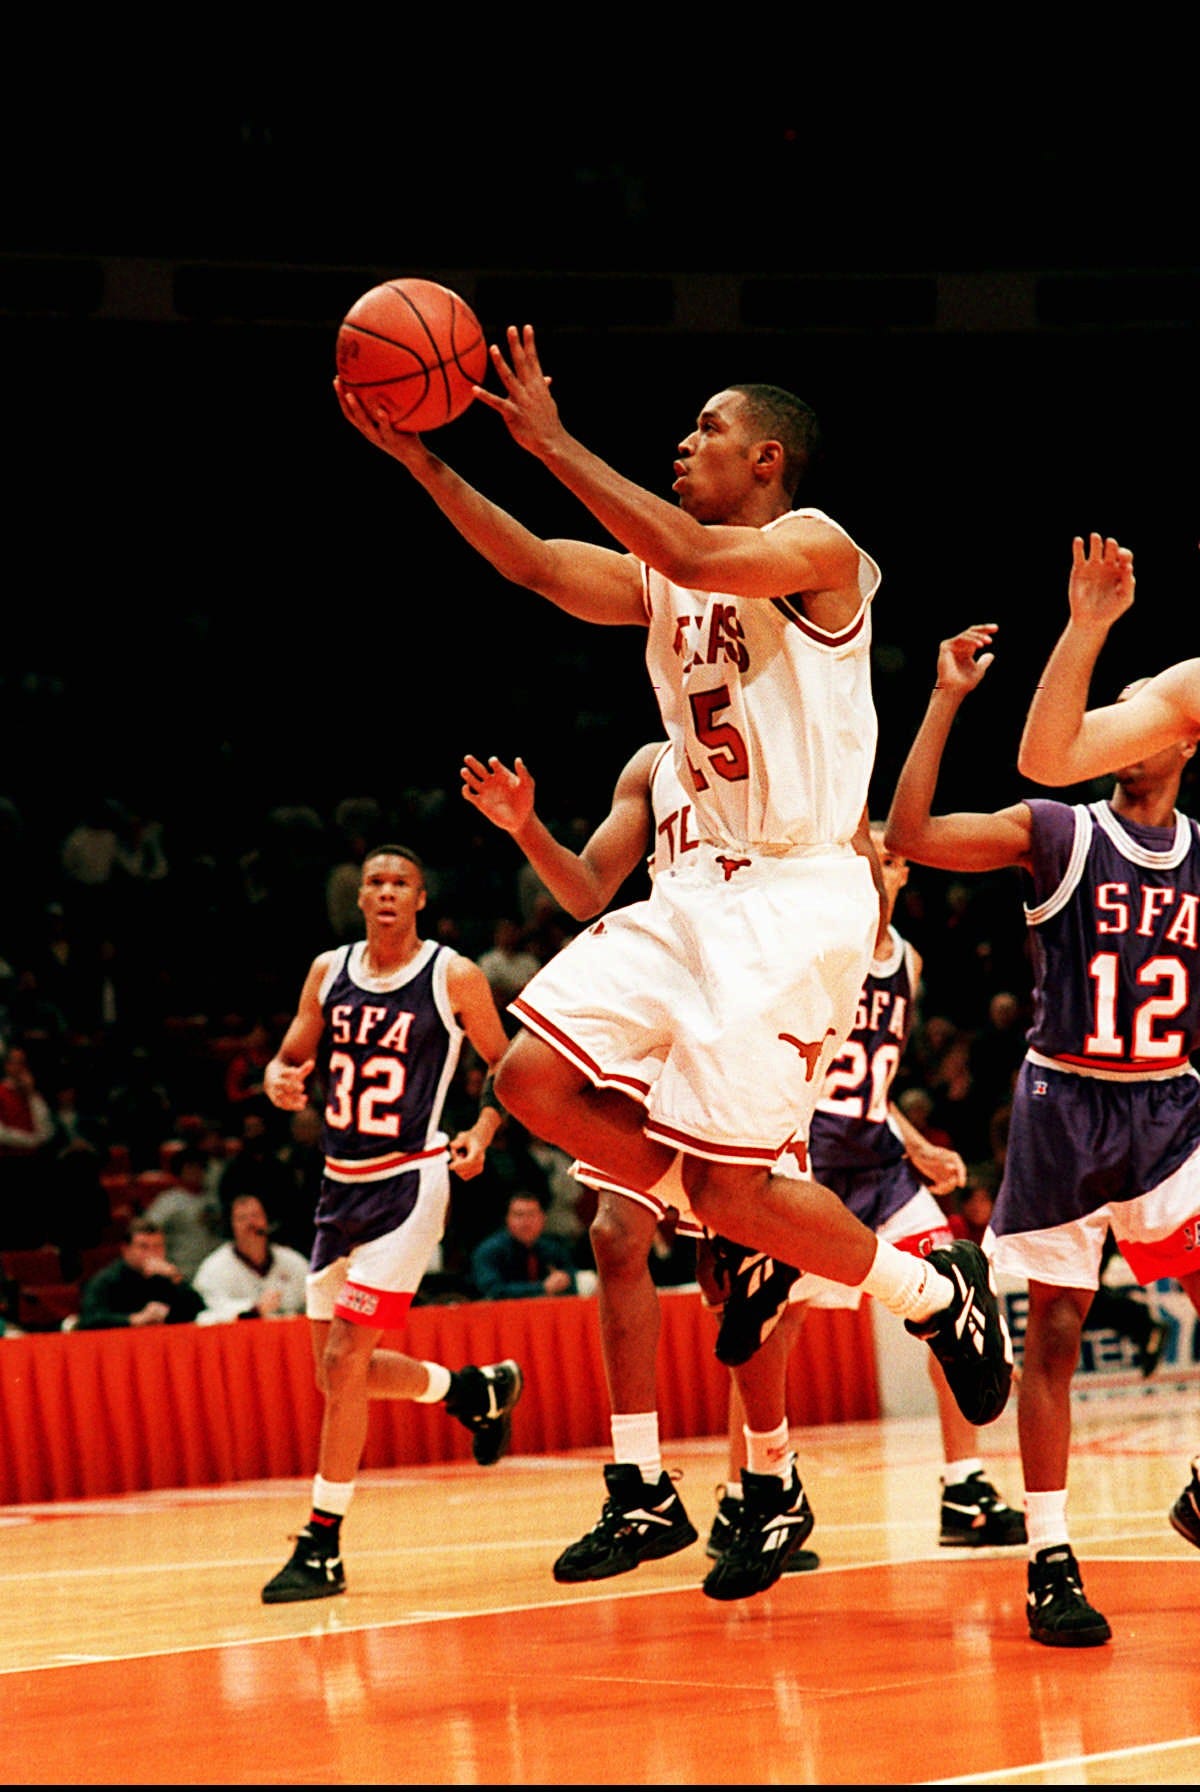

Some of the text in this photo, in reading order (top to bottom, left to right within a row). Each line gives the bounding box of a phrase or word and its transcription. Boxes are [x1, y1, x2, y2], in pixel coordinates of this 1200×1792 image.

[1096, 881, 1200, 949] SFA
[331, 1003, 416, 1053] SFA
[1083, 950, 1189, 1060] 12
[325, 1050, 406, 1138] 32
